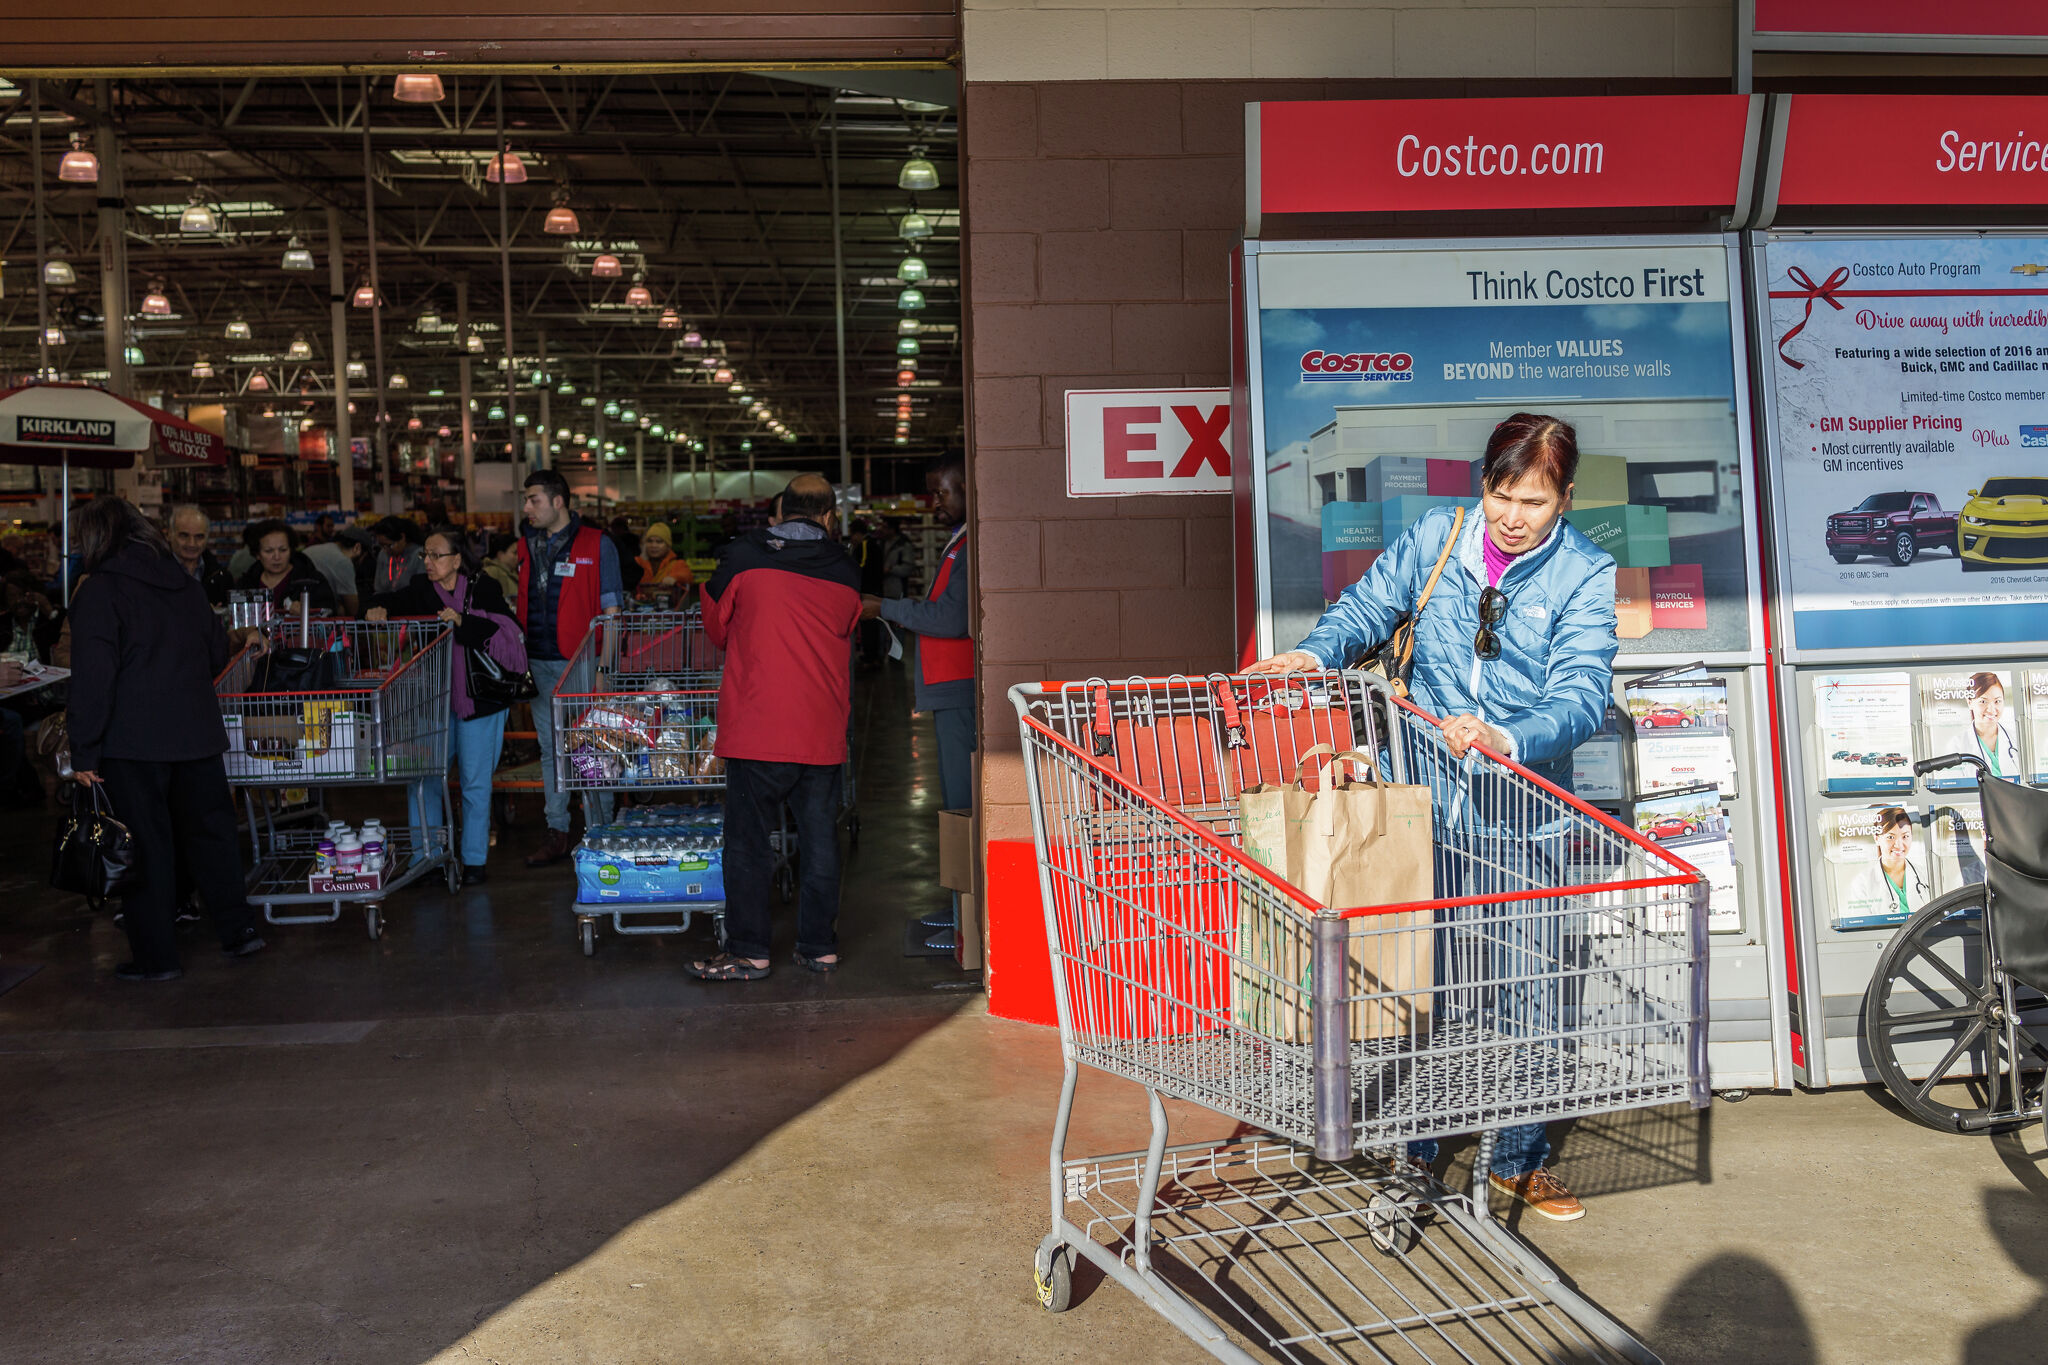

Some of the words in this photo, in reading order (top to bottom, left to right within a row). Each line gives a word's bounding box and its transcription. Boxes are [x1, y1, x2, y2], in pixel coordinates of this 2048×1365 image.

[1396, 134, 1604, 177] Costco.com
[1852, 262, 1894, 276] Costco
[1898, 262, 1925, 276] Auto
[1930, 262, 1981, 278] Program
[1466, 271, 1538, 300] Think
[1547, 269, 1635, 299] Costco
[1643, 267, 1705, 297] First
[1855, 309, 1905, 331] Drive
[1910, 316, 1948, 335] away
[1953, 309, 1984, 327] with
[1989, 309, 2048, 327] incredib
[1489, 341, 1552, 359] Member
[1556, 339, 1624, 357] VALUES
[1834, 347, 1890, 360] Featuring
[1893, 349, 1901, 358] a
[1904, 346, 1931, 358] wide
[1935, 346, 1986, 358] selection
[1990, 345, 2001, 357] of
[2004, 345, 2032, 357] 2016
[1301, 351, 1412, 373] COSTCO
[1901, 361, 1937, 374] Buick,
[1940, 361, 1966, 372] GMC
[1969, 360, 1989, 372] and
[1993, 360, 2039, 371] Cadillac
[1363, 372, 1412, 382] SERVICES
[1443, 362, 1514, 380] BEYOND
[1518, 361, 1543, 379] the
[1547, 361, 1630, 379] warehouse
[1634, 360, 1672, 377] walls
[1901, 390, 1965, 402] Limited-time
[1968, 390, 2002, 402] Costco
[2005, 389, 2046, 401] member
[22, 417, 113, 436] KIRKLAND
[1820, 417, 1843, 432] GM
[1848, 416, 1908, 434] Supplier
[1912, 415, 1962, 432] Pricing
[179, 428, 193, 443] ALL
[194, 432, 212, 447] BEEF
[1103, 405, 1231, 479] EX
[1972, 428, 2010, 447] Plus
[167, 440, 184, 455] HOT
[184, 443, 209, 460] DOGS
[1822, 442, 1849, 456] Most
[1852, 441, 1902, 457] currently
[1905, 440, 1955, 454] available
[1823, 459, 1843, 472] GM
[1846, 458, 1904, 472] incentives
[1384, 481, 1427, 489] PROCESSING
[1343, 527, 1374, 535] HEALTH
[1583, 521, 1611, 538] ENTITY
[1591, 526, 1622, 545] ECTION
[1335, 535, 1383, 543] INSURANCE
[1839, 572, 1855, 580] 2016
[1615, 597, 1632, 605] CKS
[1655, 592, 1693, 600] PAYROLL
[1655, 600, 1694, 609] SERVICES
[1934, 688, 1976, 700] Services
[1949, 807, 1982, 821] MyCost
[1839, 824, 1883, 837] Services
[1948, 819, 1985, 831] Service
[322, 882, 370, 892] CASHEWS
